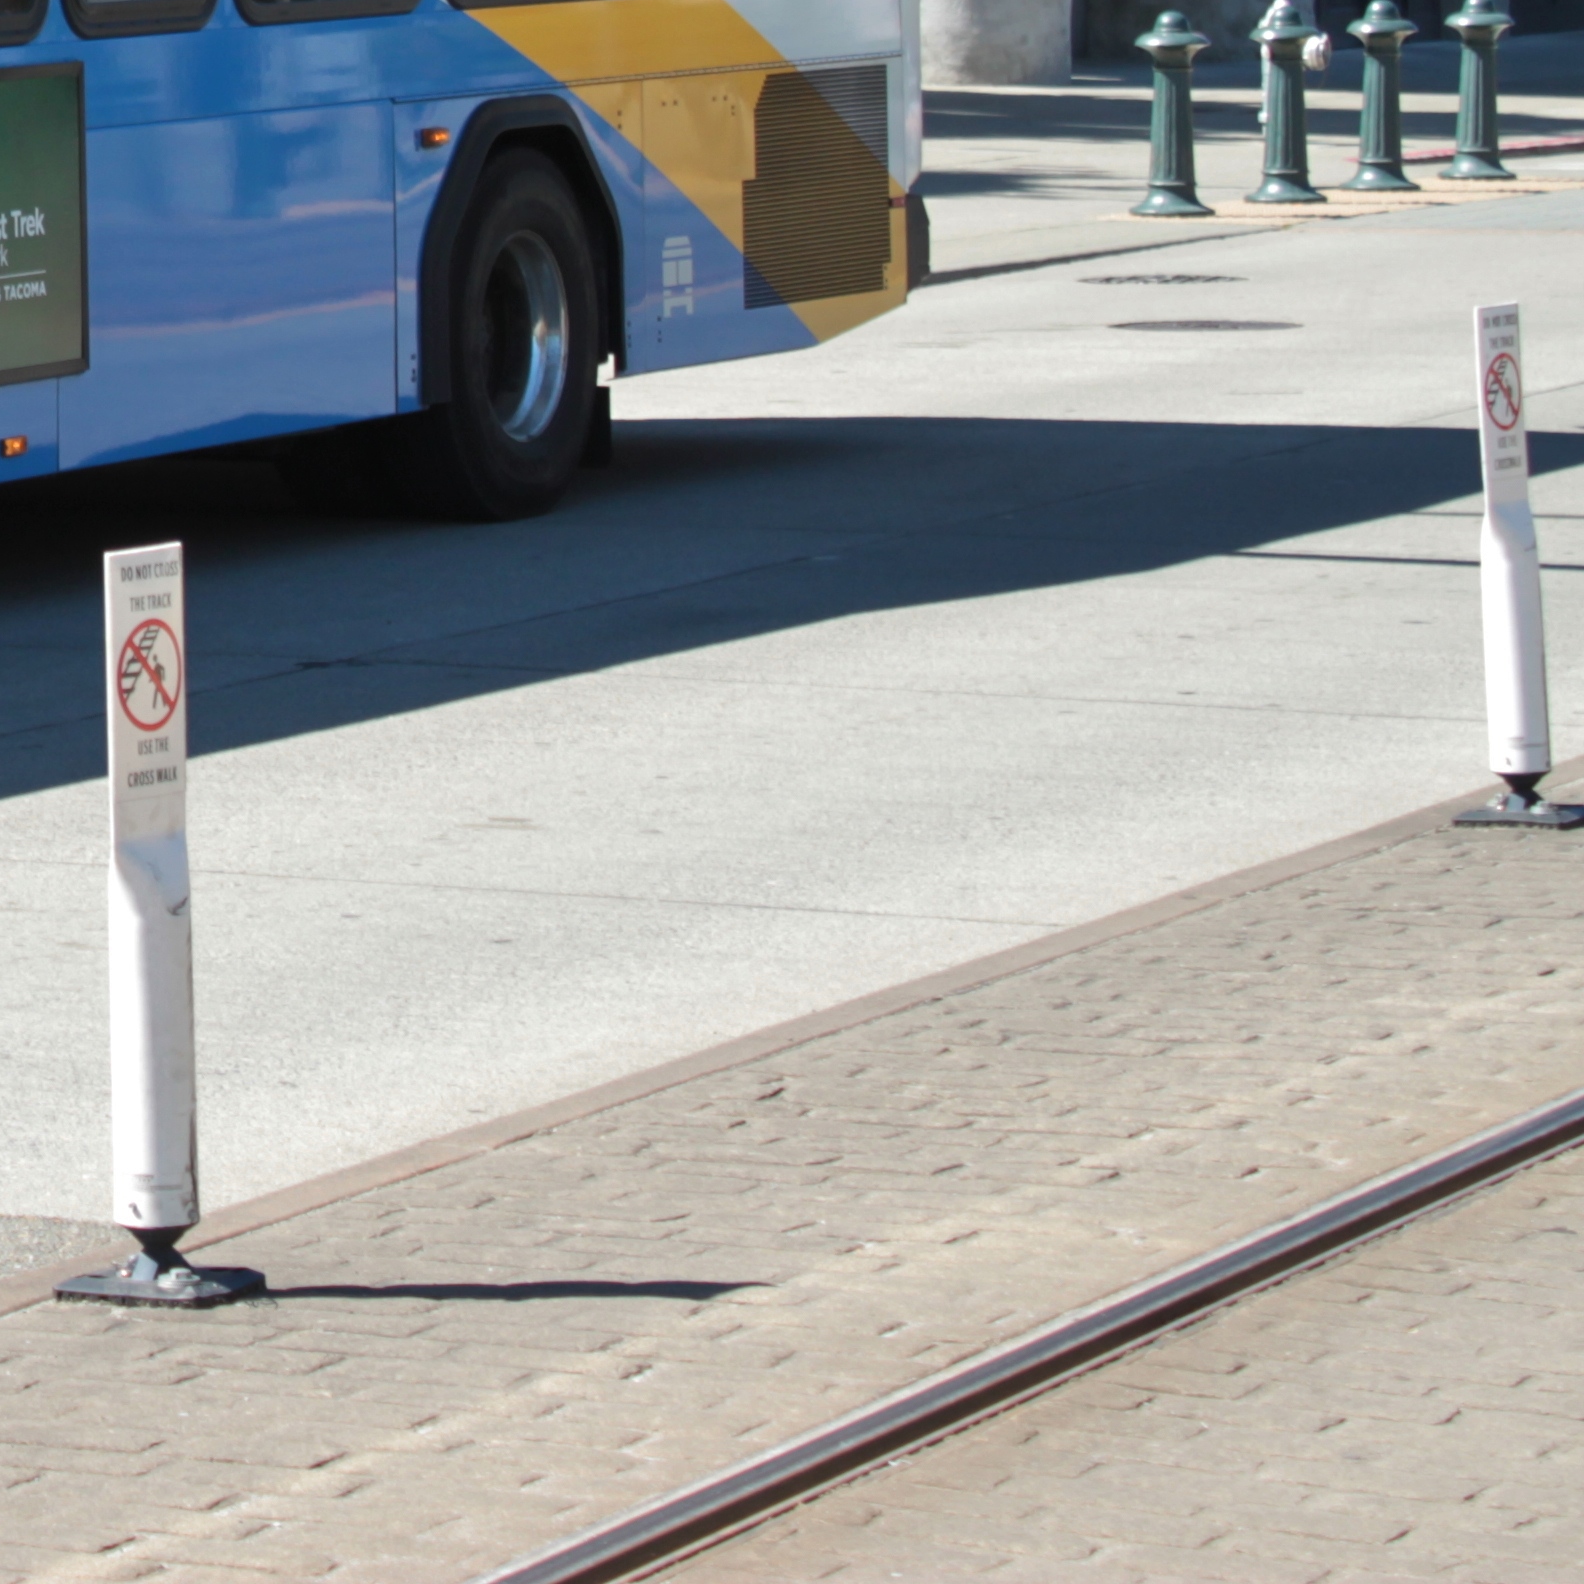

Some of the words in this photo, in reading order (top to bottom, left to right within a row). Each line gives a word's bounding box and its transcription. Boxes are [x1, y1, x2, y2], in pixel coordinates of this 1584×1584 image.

[10, 207, 45, 238] Trek
[3, 280, 47, 301] TACOMA
[121, 566, 133, 582] DO
[136, 564, 152, 580] NOT
[154, 560, 179, 578] CROSS
[130, 596, 145, 612] THE
[147, 593, 172, 610] TRACK
[137, 739, 153, 755] USE
[154, 736, 169, 753] THE
[127, 770, 154, 787] CROSS
[156, 766, 177, 783] WALK
